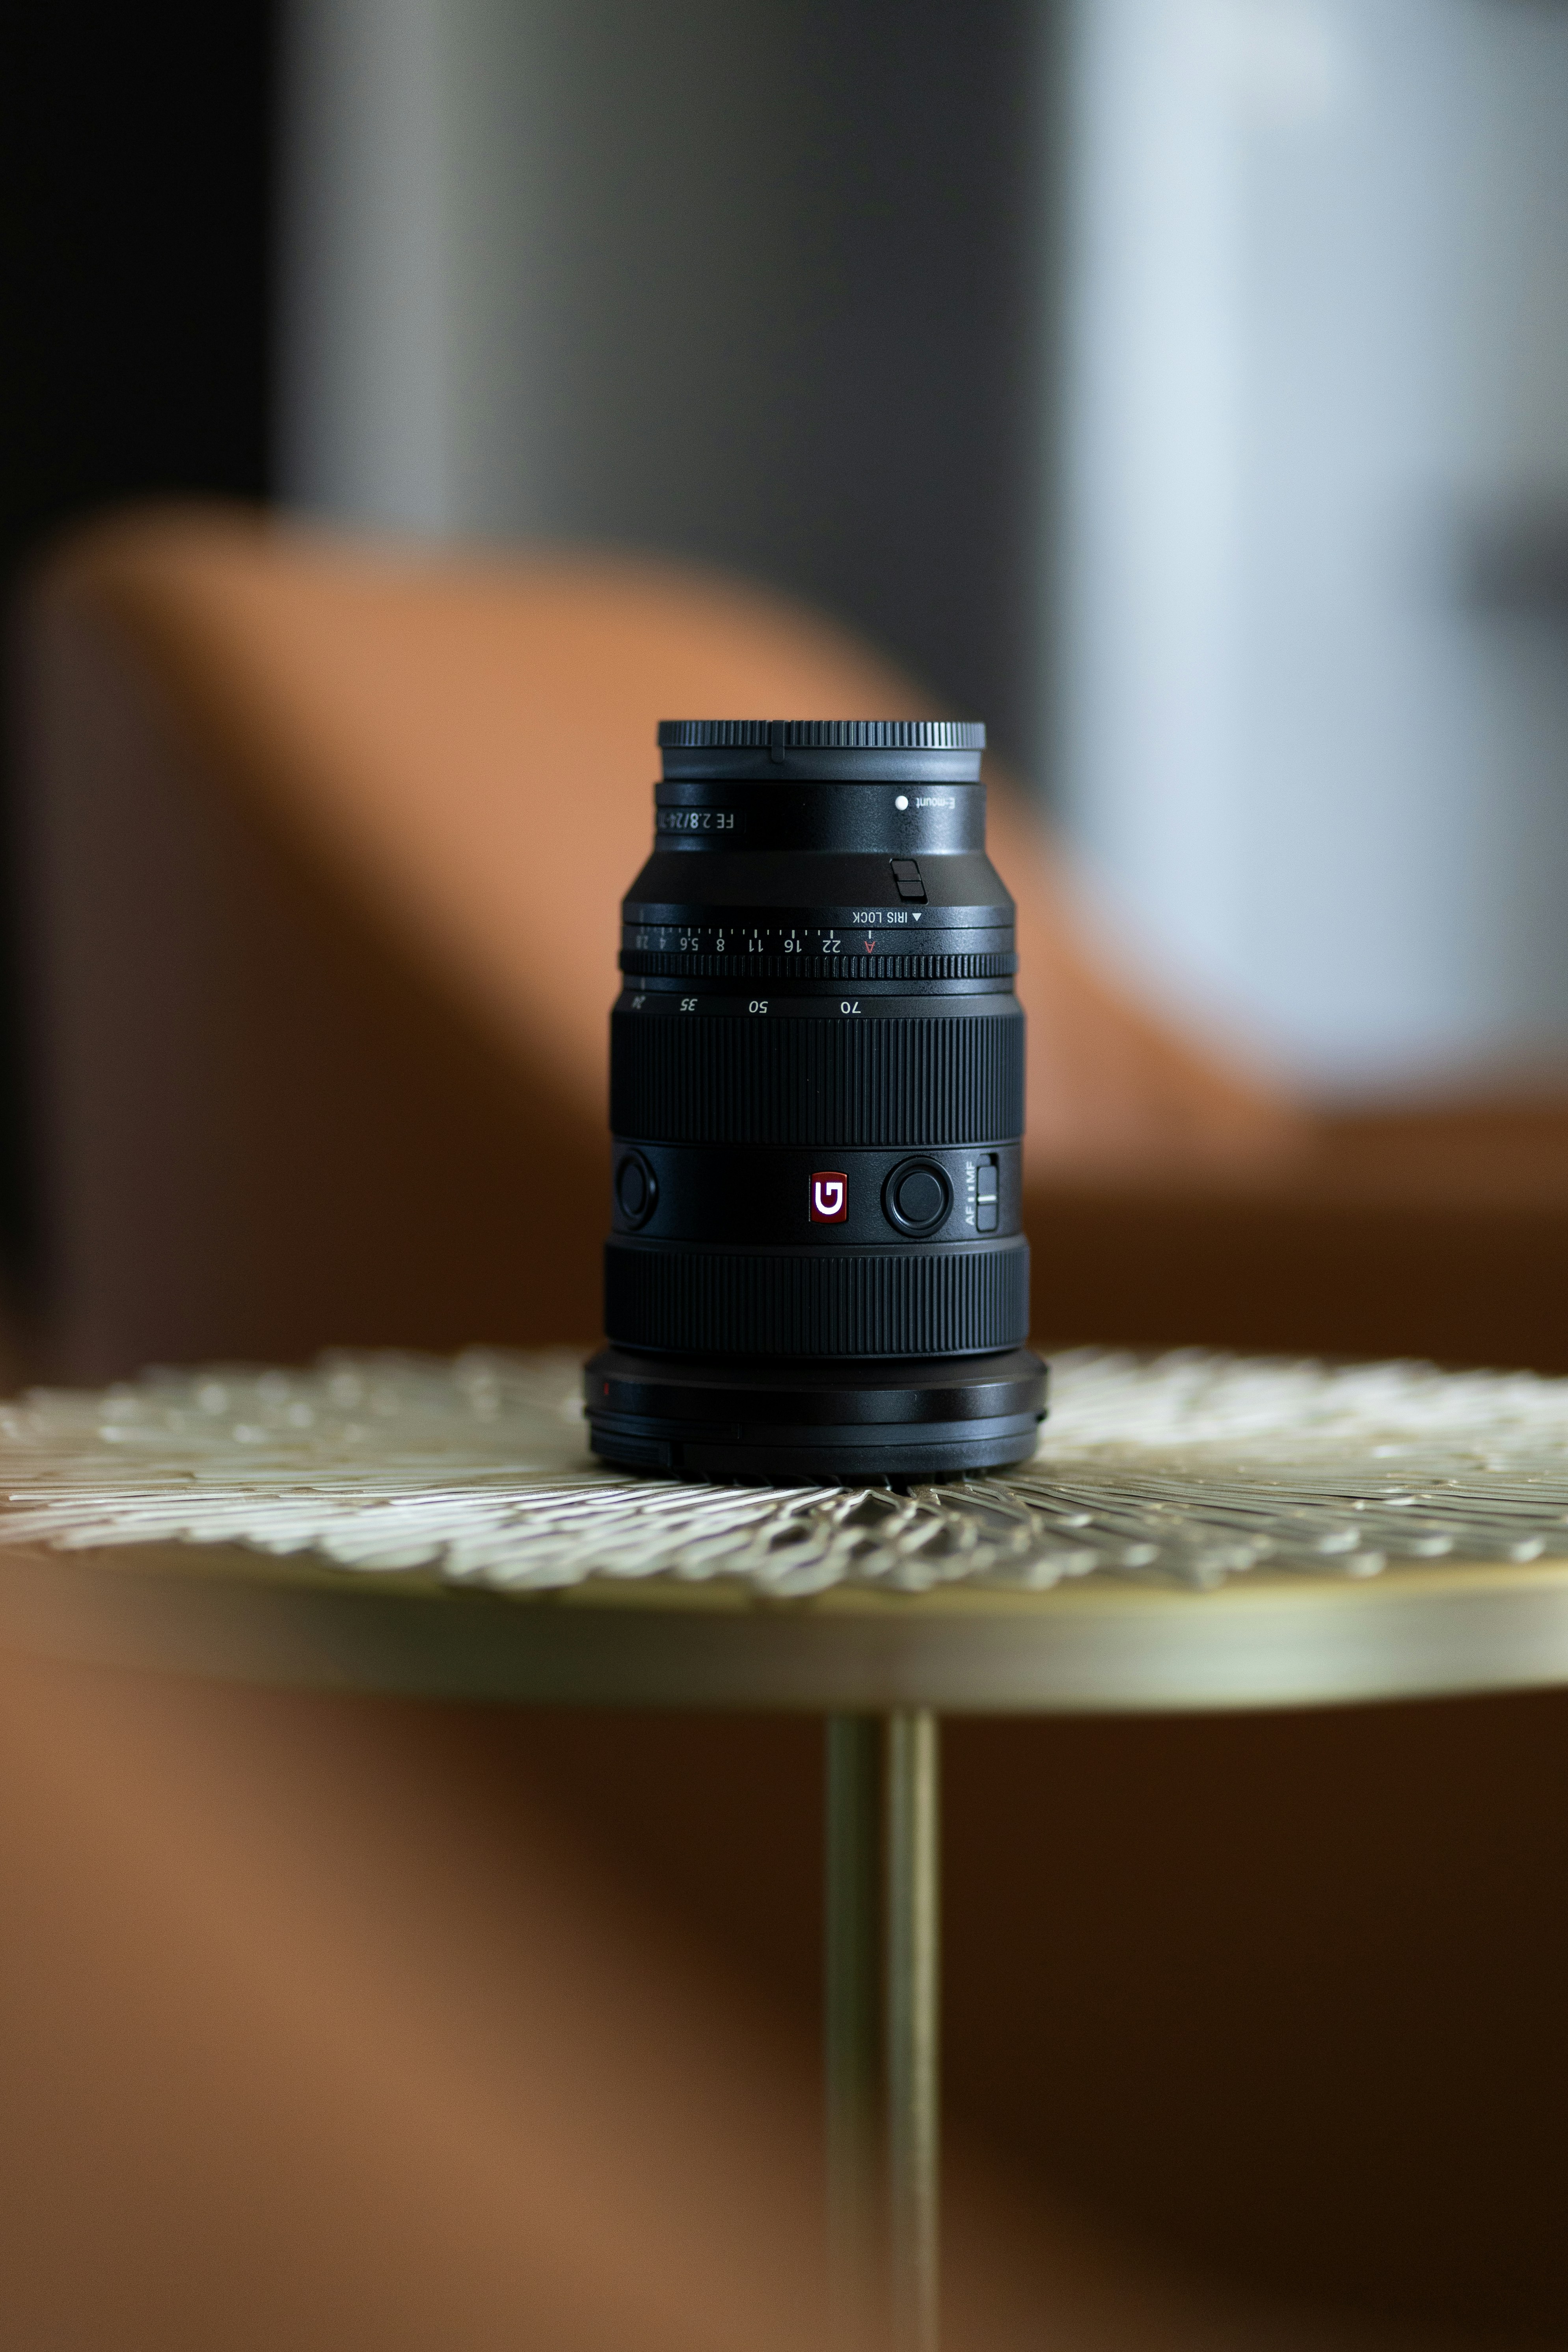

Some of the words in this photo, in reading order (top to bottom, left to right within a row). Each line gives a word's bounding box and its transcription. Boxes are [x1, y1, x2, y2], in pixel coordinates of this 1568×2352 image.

[916, 797, 955, 810] E-mount
[716, 814, 734, 829] FE
[852, 912, 882, 924] LOCK
[886, 912, 907, 923] IRIS
[680, 937, 698, 951] 5.6
[716, 939, 725, 952] 8
[749, 939, 764, 952] 11
[784, 939, 802, 953] 16
[822, 940, 841, 953] 22
[864, 940, 876, 953] A
[680, 998, 698, 1011] 35
[749, 1000, 769, 1013] 50
[840, 1001, 861, 1014] 70
[966, 1161, 975, 1183] MF
[815, 1182, 843, 1215] G
[965, 1205, 975, 1225] AF
